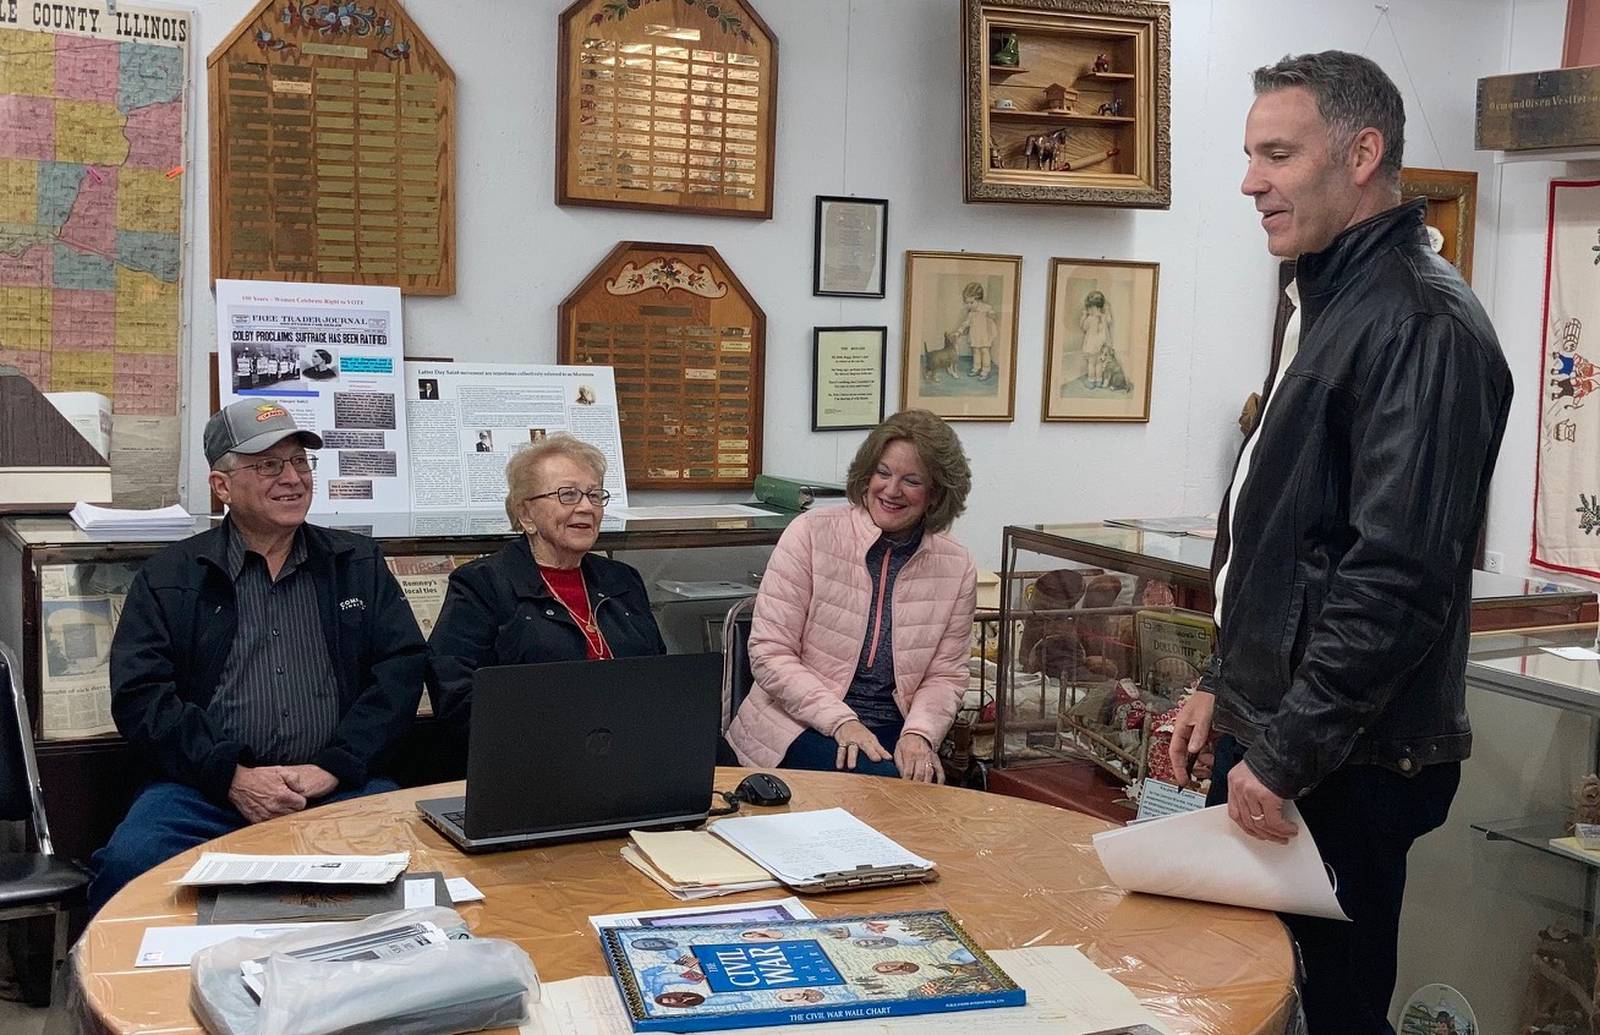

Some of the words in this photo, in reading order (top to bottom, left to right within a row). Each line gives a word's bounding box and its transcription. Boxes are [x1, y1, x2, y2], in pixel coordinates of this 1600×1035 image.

[116, 12, 186, 42] ILLINOIS
[252, 314, 279, 322] FREE
[232, 330, 254, 342] COLBY
[255, 330, 294, 343] PROCLAIMS
[295, 331, 327, 344] SUFFRAGE
[328, 332, 342, 344] HAS
[342, 333, 359, 344] BEEN
[359, 333, 388, 346] RATIFIED
[402, 579, 438, 587] Romney's
[405, 586, 422, 594] local
[716, 947, 760, 987] CIVIL
[749, 945, 800, 986] WAR
[789, 1013, 805, 1022] THE
[805, 1012, 825, 1021] CIVIL
[826, 1010, 844, 1019] WAR
[844, 1009, 865, 1017] WALL
[865, 1006, 892, 1015] CHART
